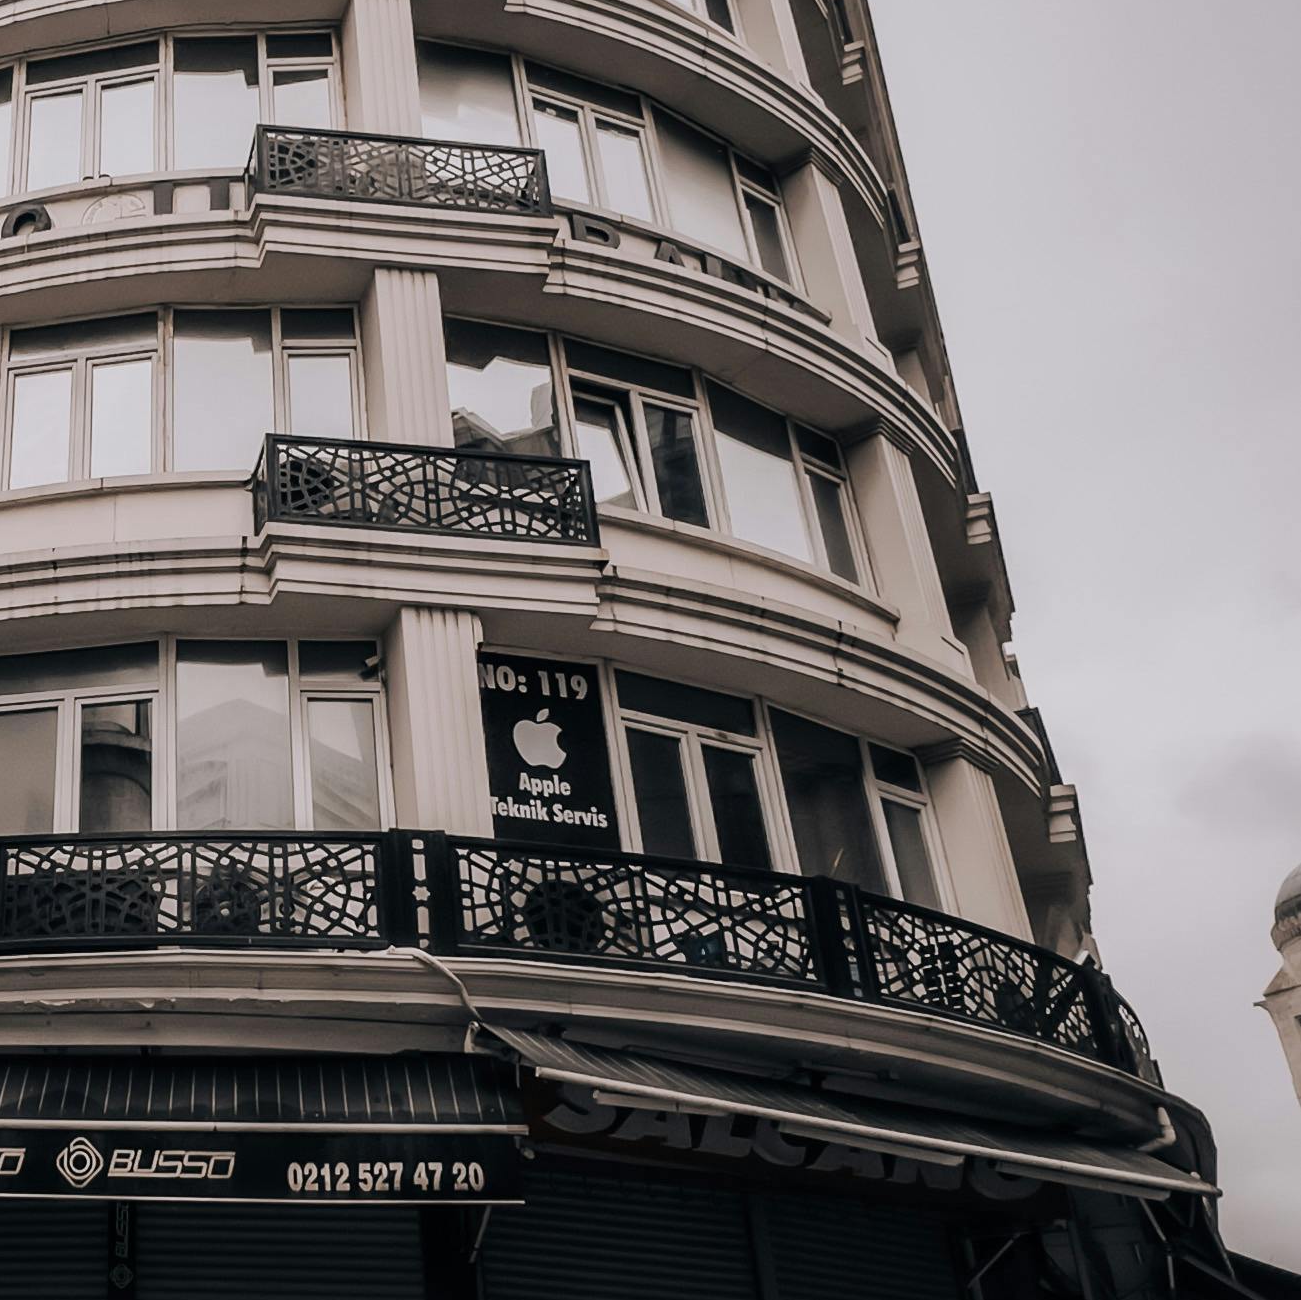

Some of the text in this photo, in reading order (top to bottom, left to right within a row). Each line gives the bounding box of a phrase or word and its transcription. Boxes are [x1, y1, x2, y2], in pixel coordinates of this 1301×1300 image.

[478, 662, 589, 700] NO: 119
[519, 772, 572, 798] Apple
[491, 796, 609, 830] Teknik Servis
[106, 1149, 236, 1180] BUSSO
[286, 1162, 486, 1193] 0212 527 47 20
